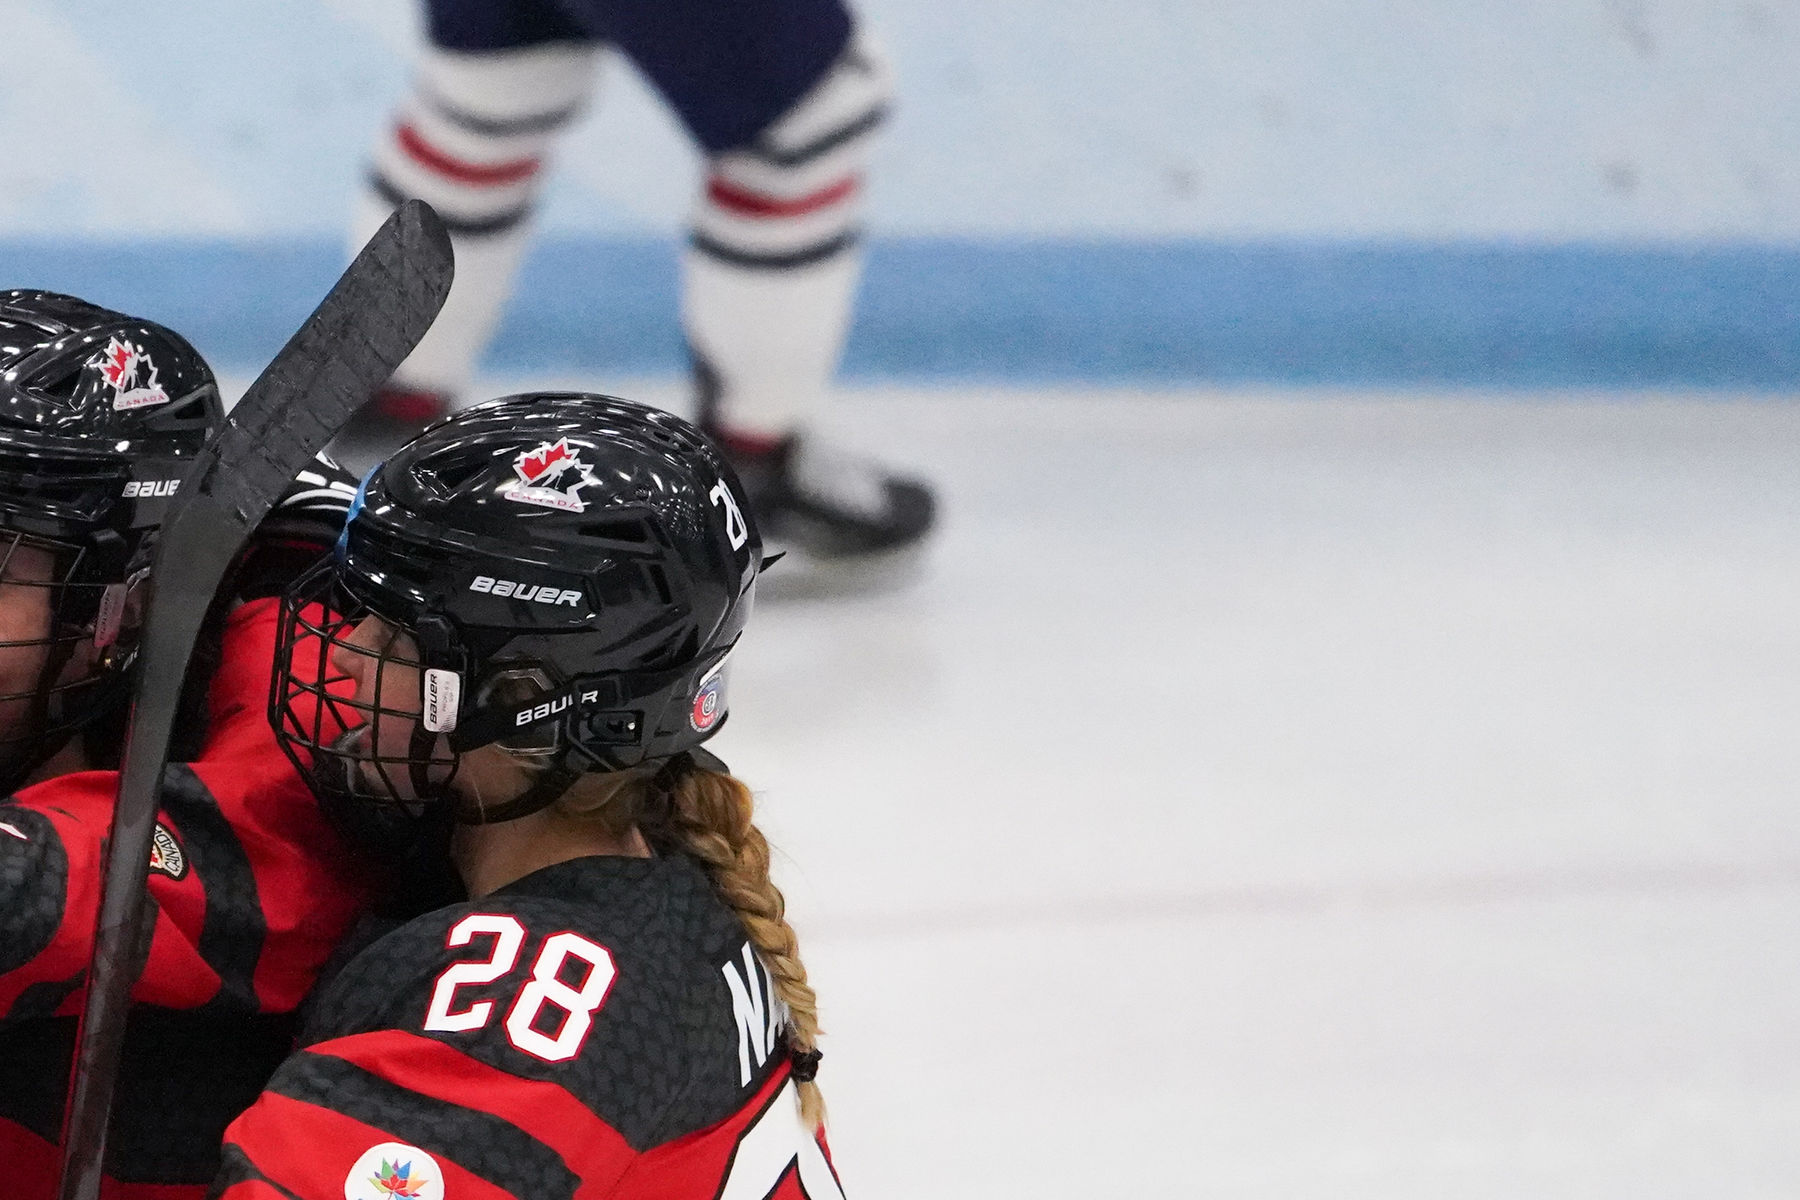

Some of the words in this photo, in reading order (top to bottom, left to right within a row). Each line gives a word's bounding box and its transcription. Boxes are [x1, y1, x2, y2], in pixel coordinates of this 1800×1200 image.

[469, 576, 583, 607] BAUER
[430, 674, 438, 725] BAUER
[422, 912, 620, 1064] 28
